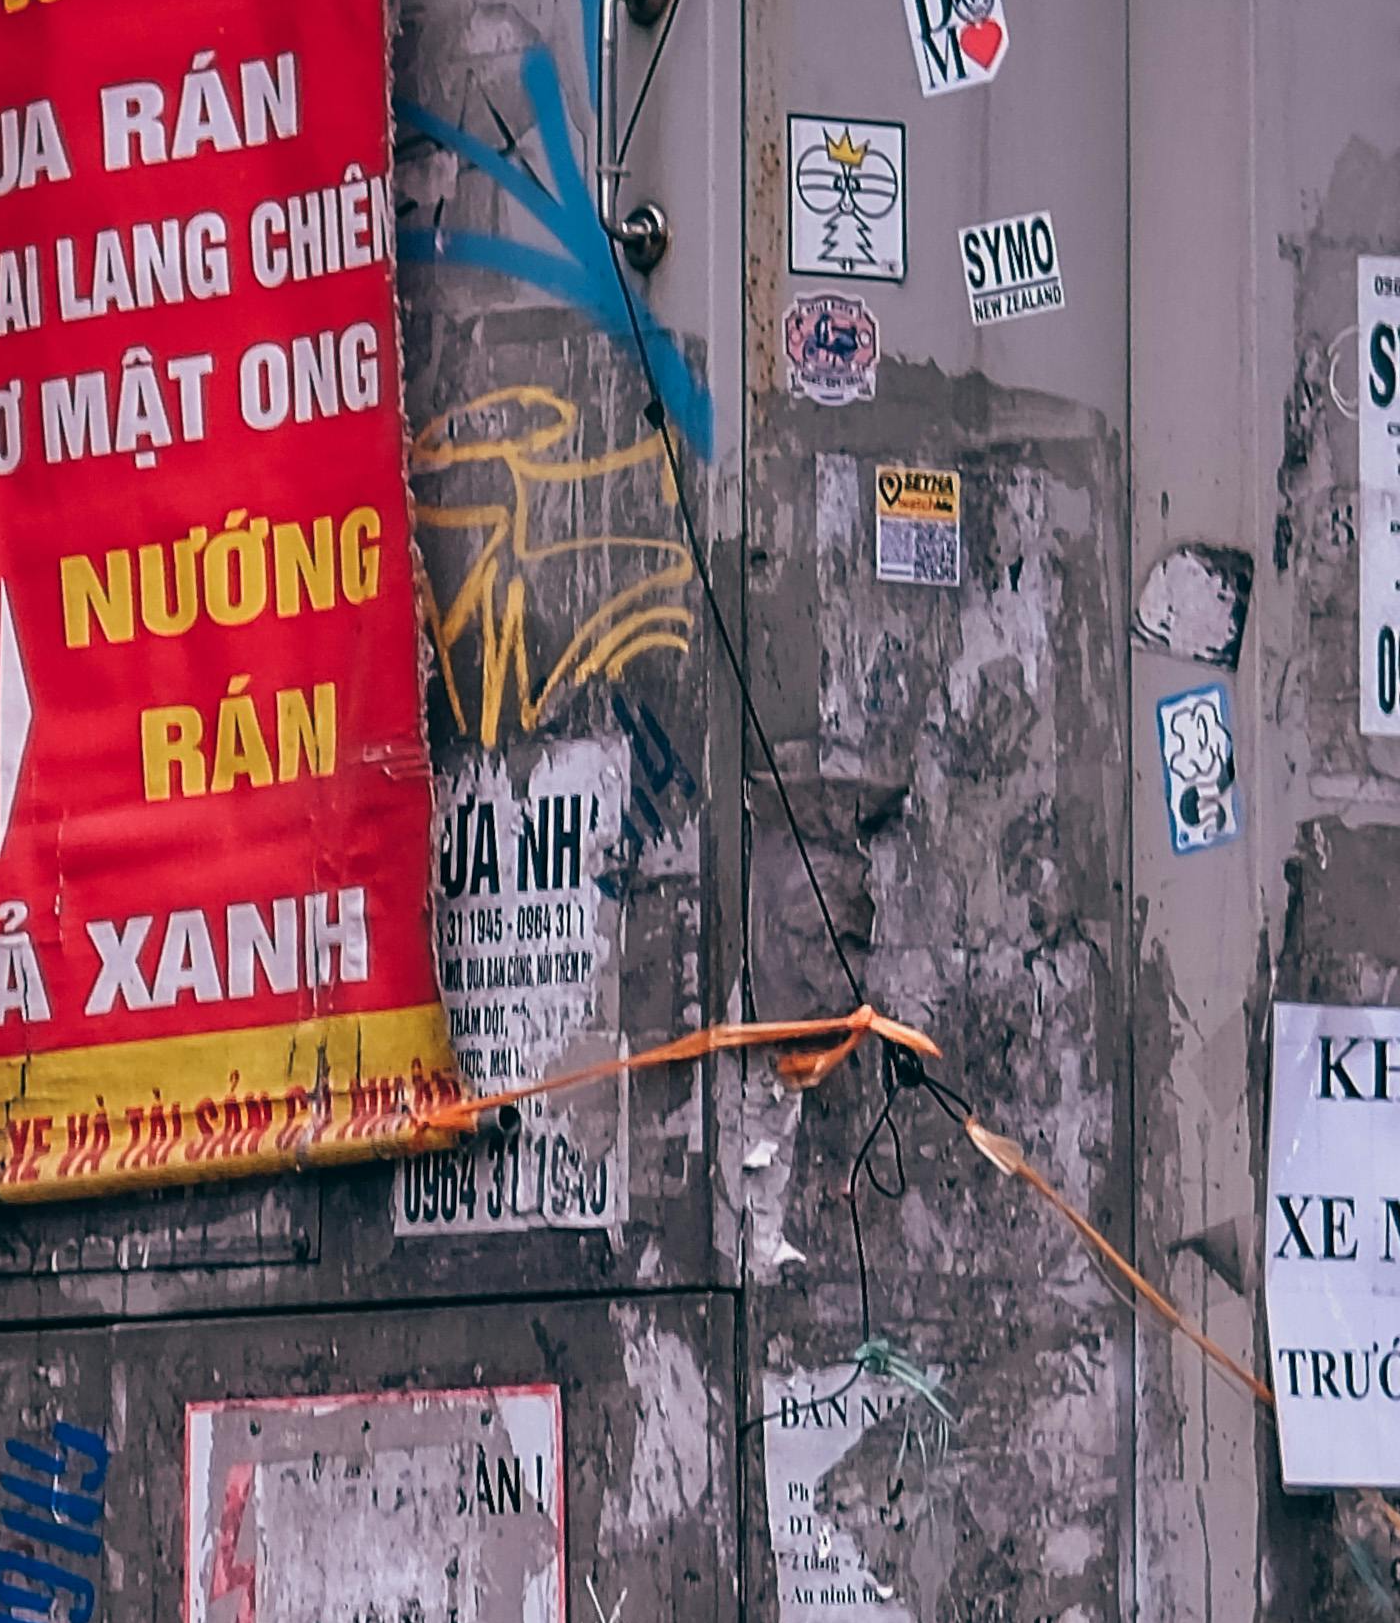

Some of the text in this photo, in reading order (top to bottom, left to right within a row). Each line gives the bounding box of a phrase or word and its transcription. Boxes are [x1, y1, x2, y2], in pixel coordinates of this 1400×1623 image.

[100, 50, 300, 172] RÁN
[56, 211, 229, 322] LANG
[964, 215, 1055, 290] SYMO
[974, 284, 1063, 323] NEW ZEALAND
[42, 347, 215, 470] MẬT
[239, 324, 379, 431] ONG
[58, 505, 382, 649] NƯỚNG
[139, 675, 339, 803] RÁN
[84, 886, 370, 1017] XANH
[1273, 1194, 1359, 1260] XE
[780, 1384, 850, 1428] BÁN
